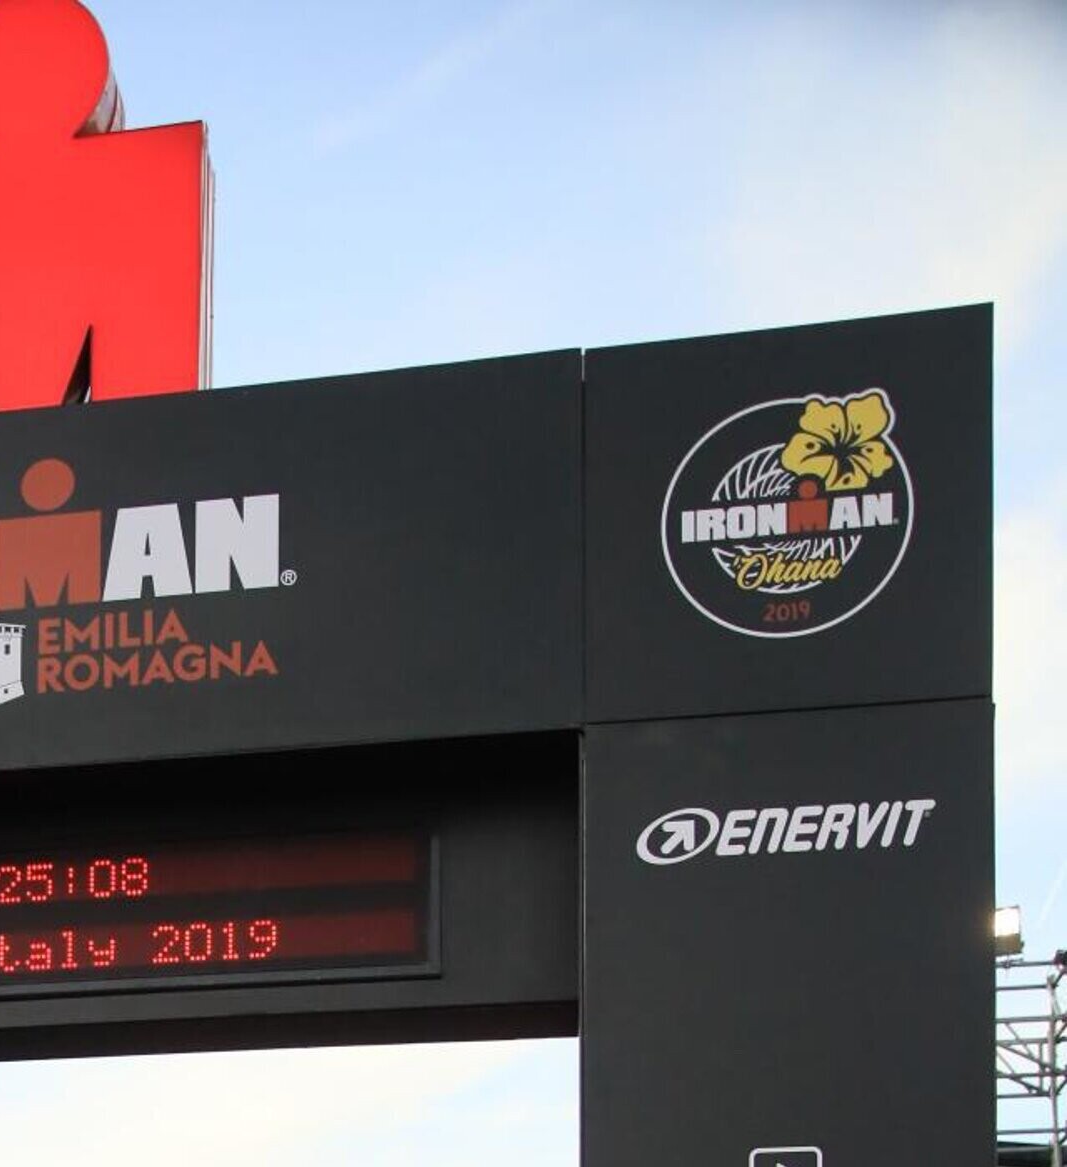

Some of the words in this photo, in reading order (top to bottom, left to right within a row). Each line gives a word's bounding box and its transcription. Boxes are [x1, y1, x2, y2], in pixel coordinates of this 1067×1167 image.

[682, 480, 894, 543] IRONMAN
[38, 609, 189, 655] EMILIA
[763, 602, 811, 621] 2019
[38, 640, 279, 694] ROMAGNA
[715, 799, 937, 857] ENERVIT
[151, 919, 277, 963] 2019
